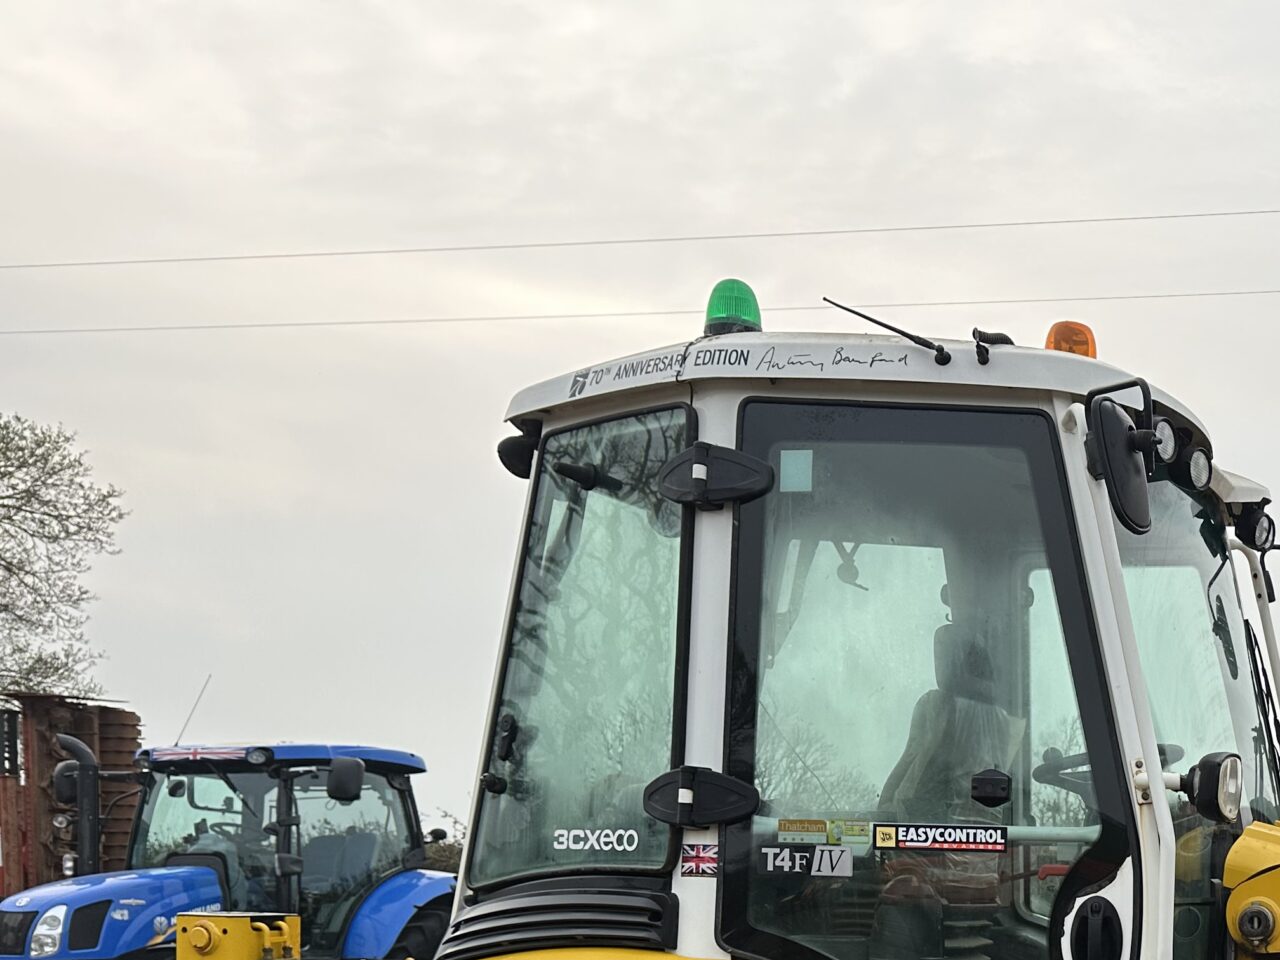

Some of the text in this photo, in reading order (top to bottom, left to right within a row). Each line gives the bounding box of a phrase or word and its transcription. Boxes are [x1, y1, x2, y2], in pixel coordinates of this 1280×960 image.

[613, 351, 691, 381] ANNIVERSARY
[694, 349, 750, 366] EDITION
[780, 821, 825, 832] Thatcham
[816, 849, 847, 873] IV
